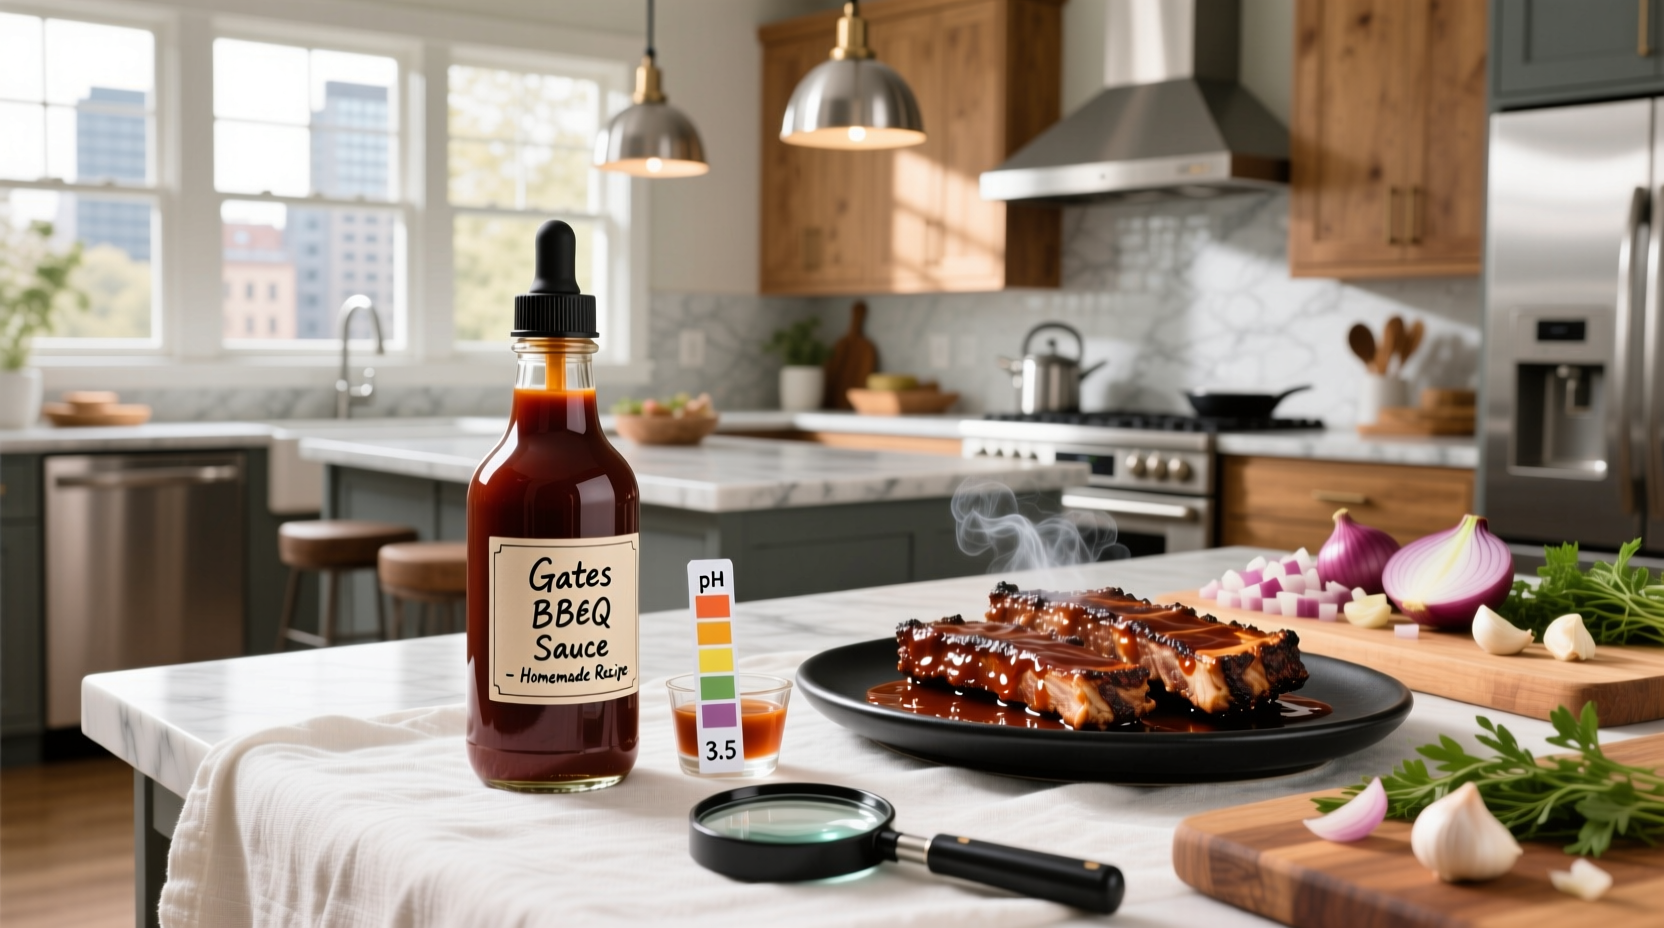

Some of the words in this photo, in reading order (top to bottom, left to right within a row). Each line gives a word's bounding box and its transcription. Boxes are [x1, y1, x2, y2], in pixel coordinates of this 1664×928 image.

[529, 557, 612, 593] Gates
[699, 570, 724, 594] pH
[533, 634, 609, 661] Sauce
[520, 666, 590, 684] Homemade
[705, 740, 737, 761] 3.5
